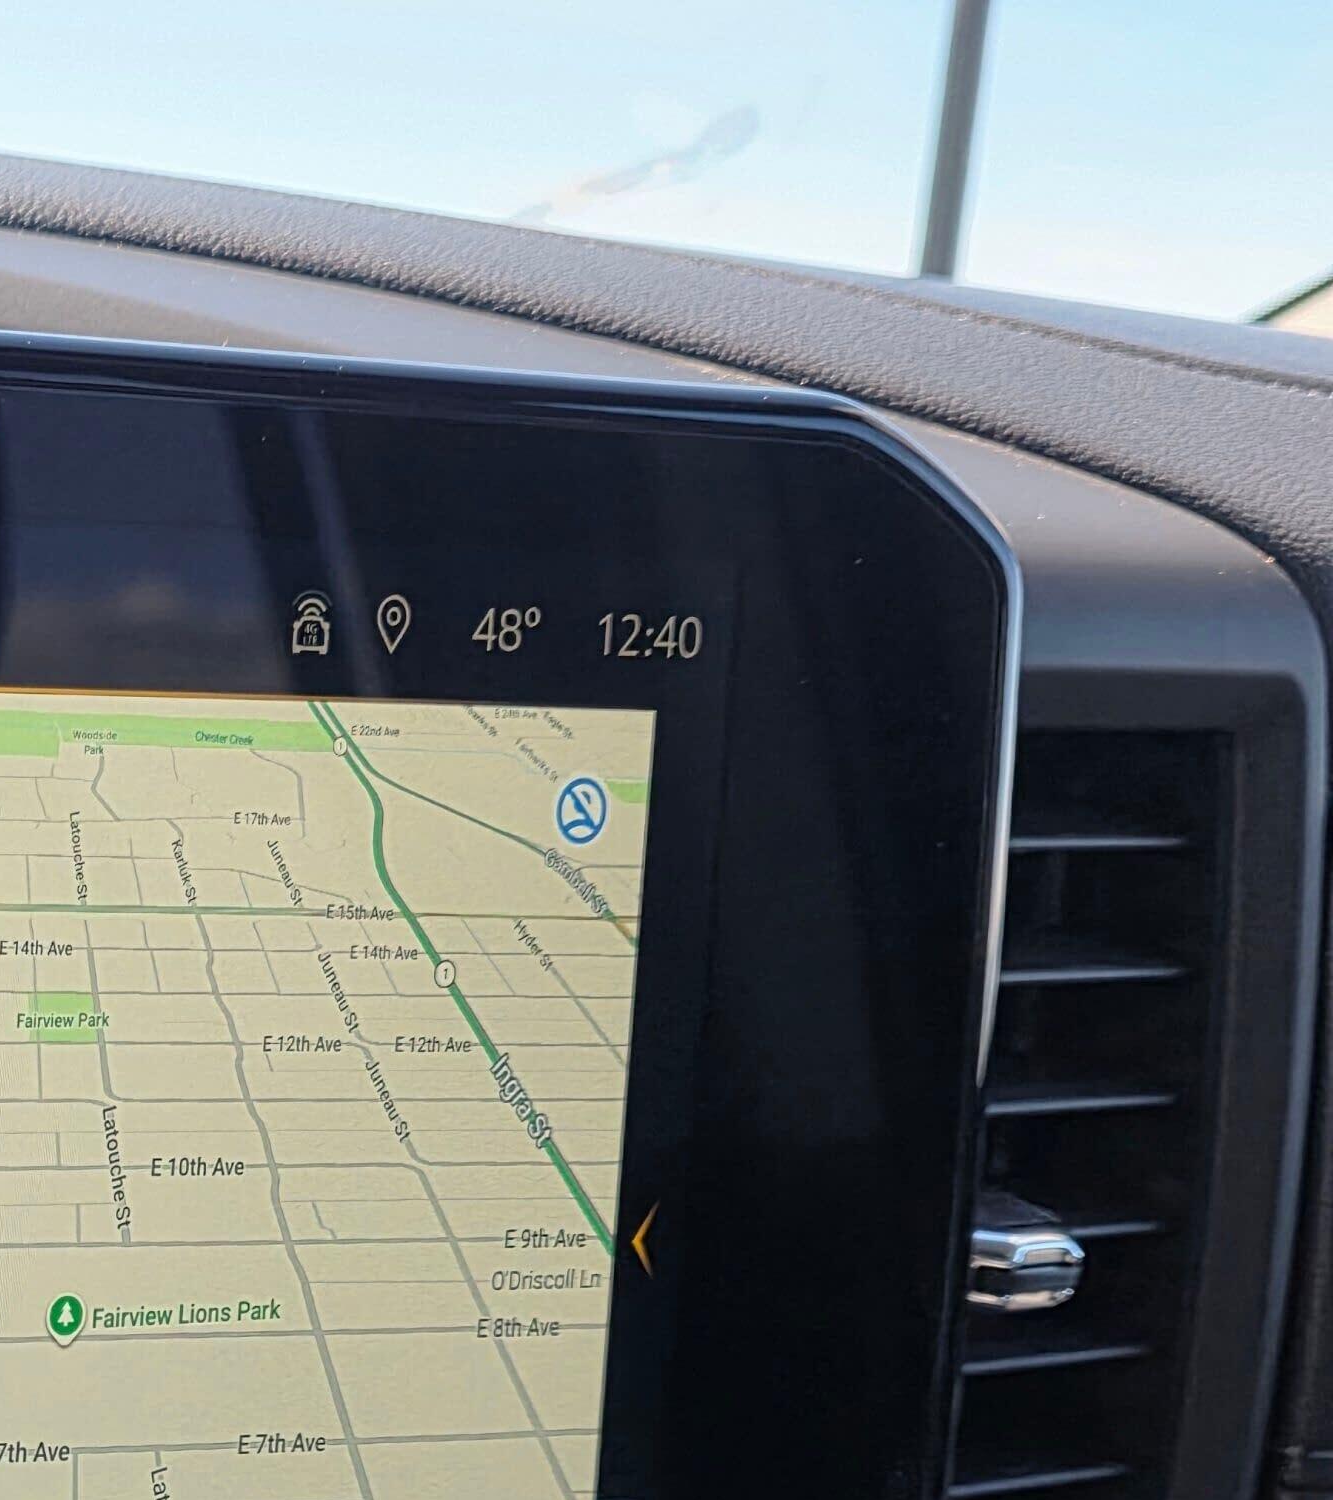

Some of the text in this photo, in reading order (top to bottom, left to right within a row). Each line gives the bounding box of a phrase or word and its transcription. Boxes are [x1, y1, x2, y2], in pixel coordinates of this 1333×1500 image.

[598, 613, 703, 660] 12:40
[72, 730, 117, 741] Woodside
[84, 745, 104, 756] Park
[234, 813, 291, 826] E 17th Ave
[0, 941, 73, 956] E 14th Ave
[350, 946, 418, 960] E 14th Ave
[17, 1013, 109, 1028] Fairview Park
[263, 1037, 342, 1052] E 12th Ave
[395, 1037, 471, 1052] E 12th Ave
[103, 1105, 131, 1229] Latouche St
[151, 1157, 245, 1176] E 10th Ave
[504, 1229, 586, 1249] E 9th Ave
[580, 1271, 601, 1289] Ln
[92, 1299, 280, 1329] Fairview Lions Park
[477, 1318, 559, 1338] E 8th Ave
[33, 1442, 71, 1462] Ave
[238, 1433, 326, 1456] E 7th Ave
